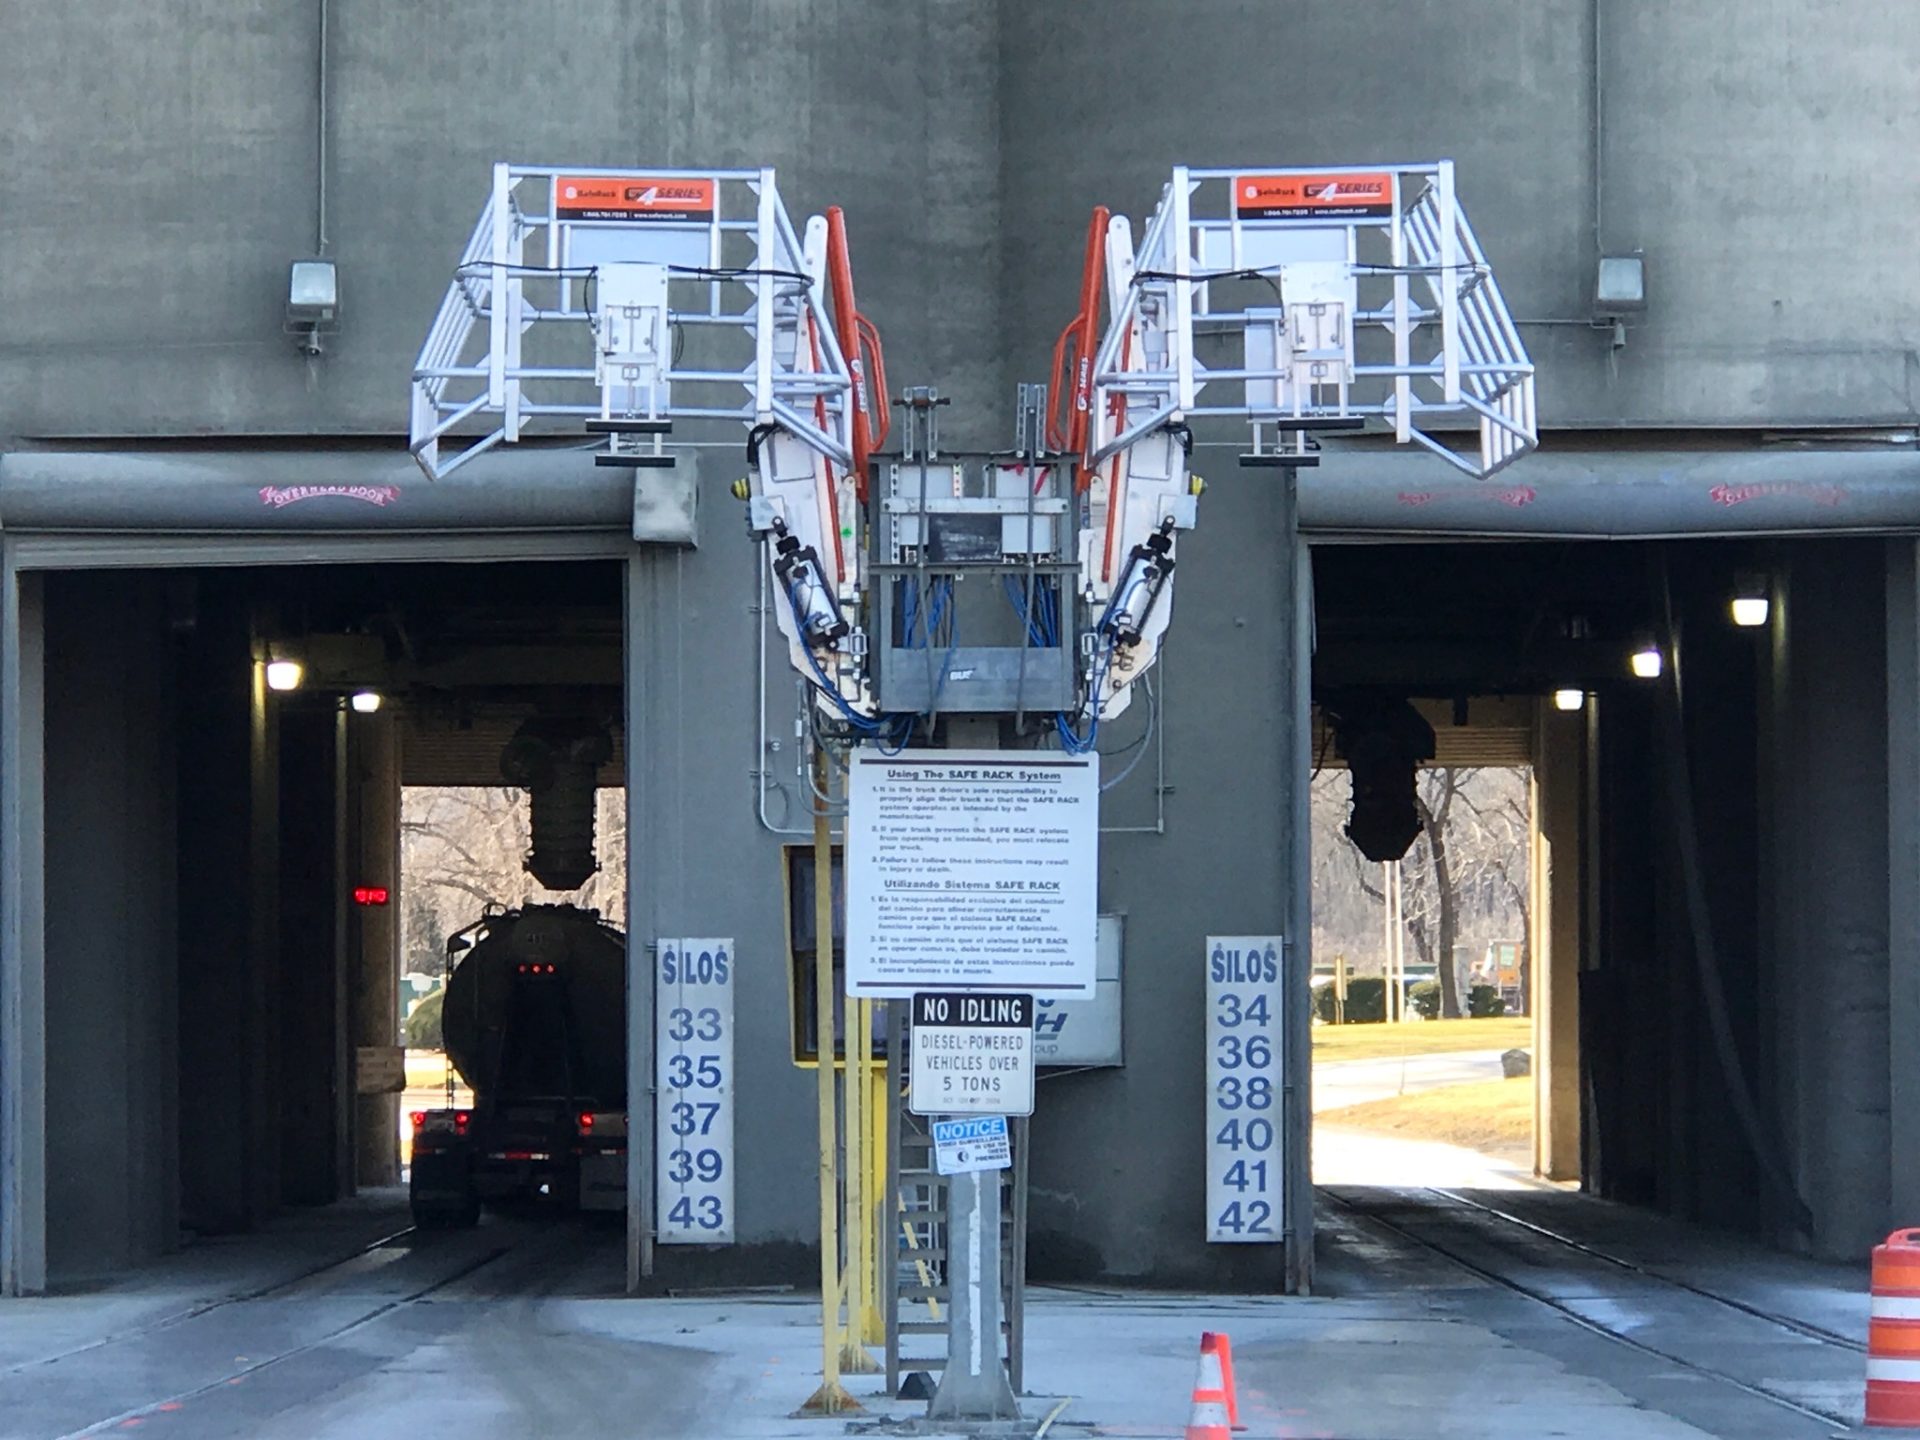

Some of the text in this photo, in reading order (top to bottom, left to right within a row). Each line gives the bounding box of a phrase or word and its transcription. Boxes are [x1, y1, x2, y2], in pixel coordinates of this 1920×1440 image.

[658, 187, 704, 198] SERIES
[1338, 182, 1382, 193] SERIES
[887, 770, 1061, 781] Using The SAFE RACK System
[884, 880, 1060, 890] Utilizando Sistema SAFE RACK
[663, 951, 728, 985] SILOS
[1211, 949, 1277, 983] SILOS
[669, 1007, 722, 1041] 33
[924, 998, 948, 1021] NO
[960, 998, 1022, 1023] IDLING
[1217, 993, 1271, 1028] 34
[922, 1034, 1023, 1050] DIESEL-POWERED
[1217, 1035, 1271, 1069] 36
[668, 1055, 721, 1089] 35
[926, 1055, 1018, 1071] VEHICLES OVER
[944, 1076, 1001, 1092] 5 TONS
[1217, 1076, 1272, 1110] 38
[671, 1102, 721, 1136] 37
[938, 1119, 1001, 1139] NOTICE
[1216, 1117, 1273, 1152] 40
[669, 1149, 722, 1183] 39
[1223, 1159, 1266, 1193] 41
[668, 1196, 723, 1230] 43
[1218, 1200, 1270, 1234] 42
